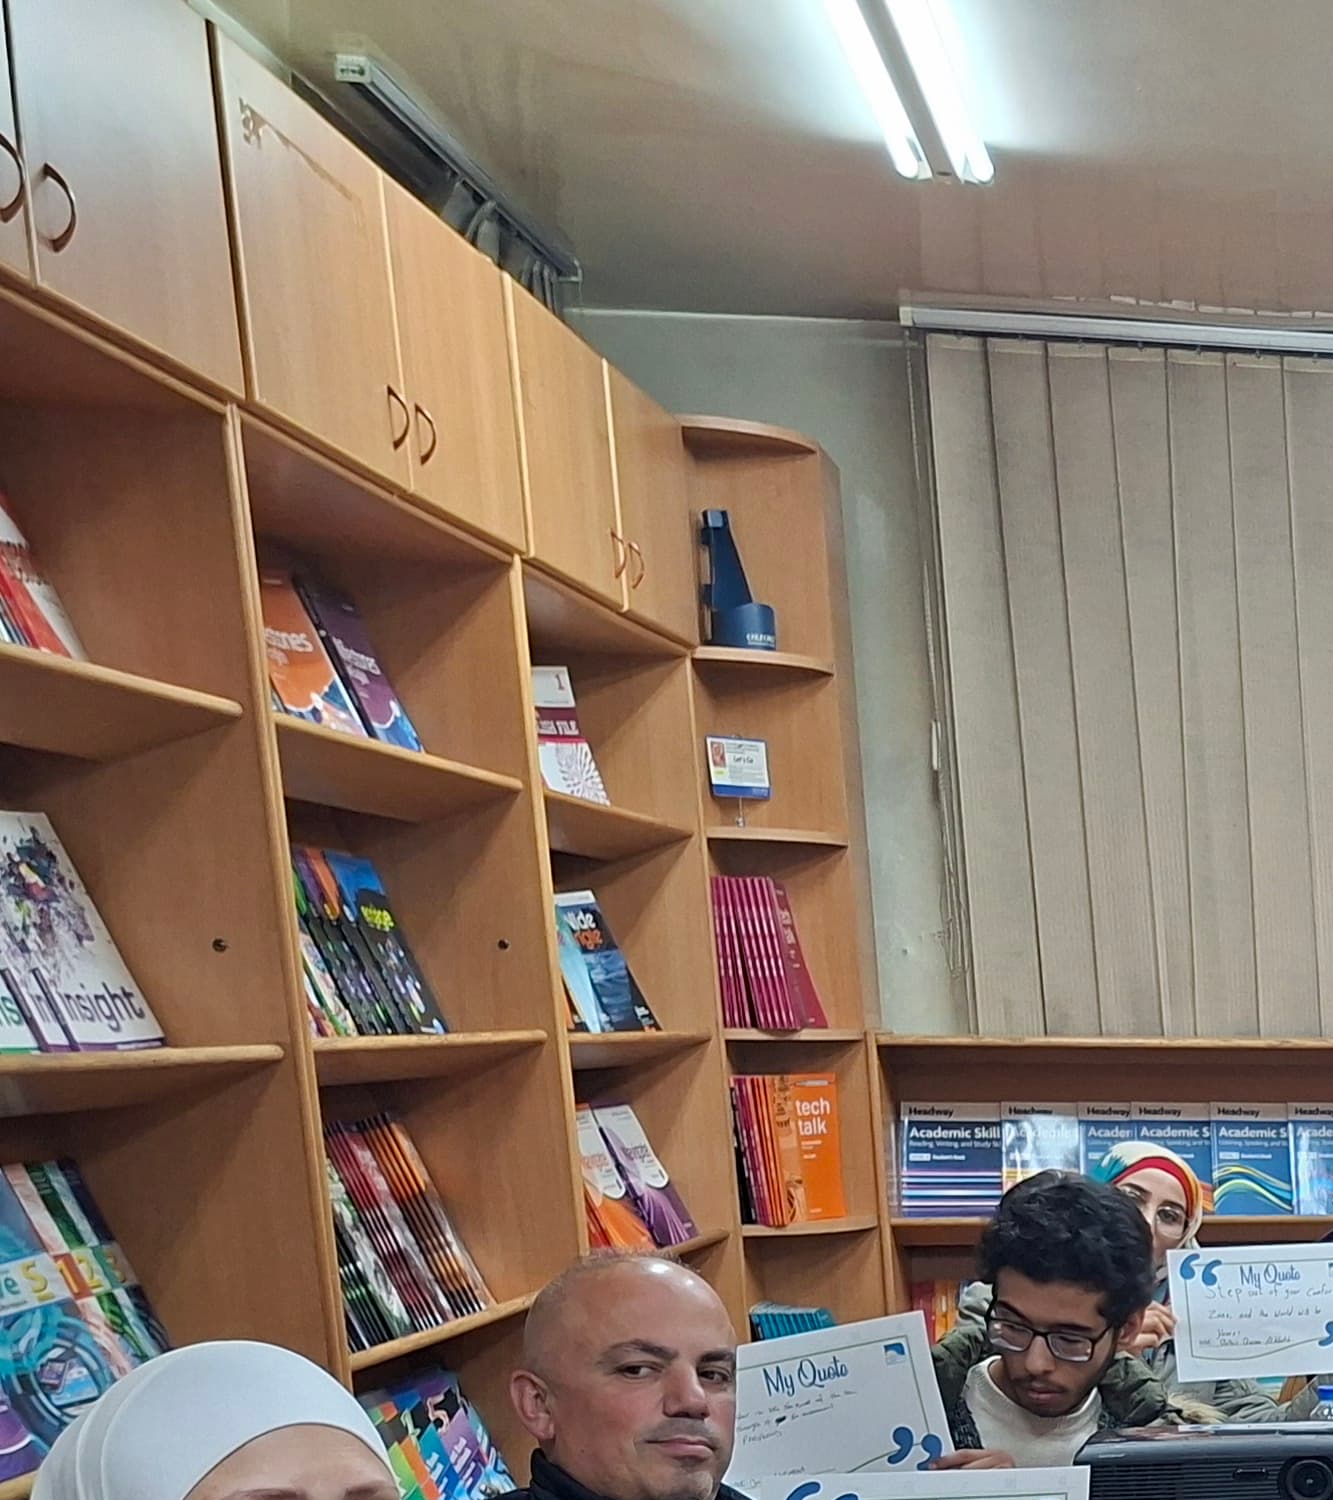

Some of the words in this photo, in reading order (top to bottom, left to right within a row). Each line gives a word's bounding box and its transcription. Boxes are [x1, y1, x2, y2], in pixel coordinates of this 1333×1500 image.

[796, 1096, 831, 1116] tech
[909, 1106, 953, 1118] Headway
[1087, 1106, 1130, 1118] Headway
[1139, 1106, 1182, 1118] Headway
[1217, 1106, 1259, 1118] Headway
[797, 1118, 828, 1136] talk
[909, 1126, 972, 1140] Academic
[1140, 1126, 1198, 1139] Academic
[1218, 1126, 1278, 1140] Academic
[1240, 1263, 1261, 1289] My
[1264, 1262, 1301, 1287] Quote
[1205, 1284, 1243, 1302] Step
[763, 1364, 796, 1398] My
[797, 1355, 849, 1389] Quote
